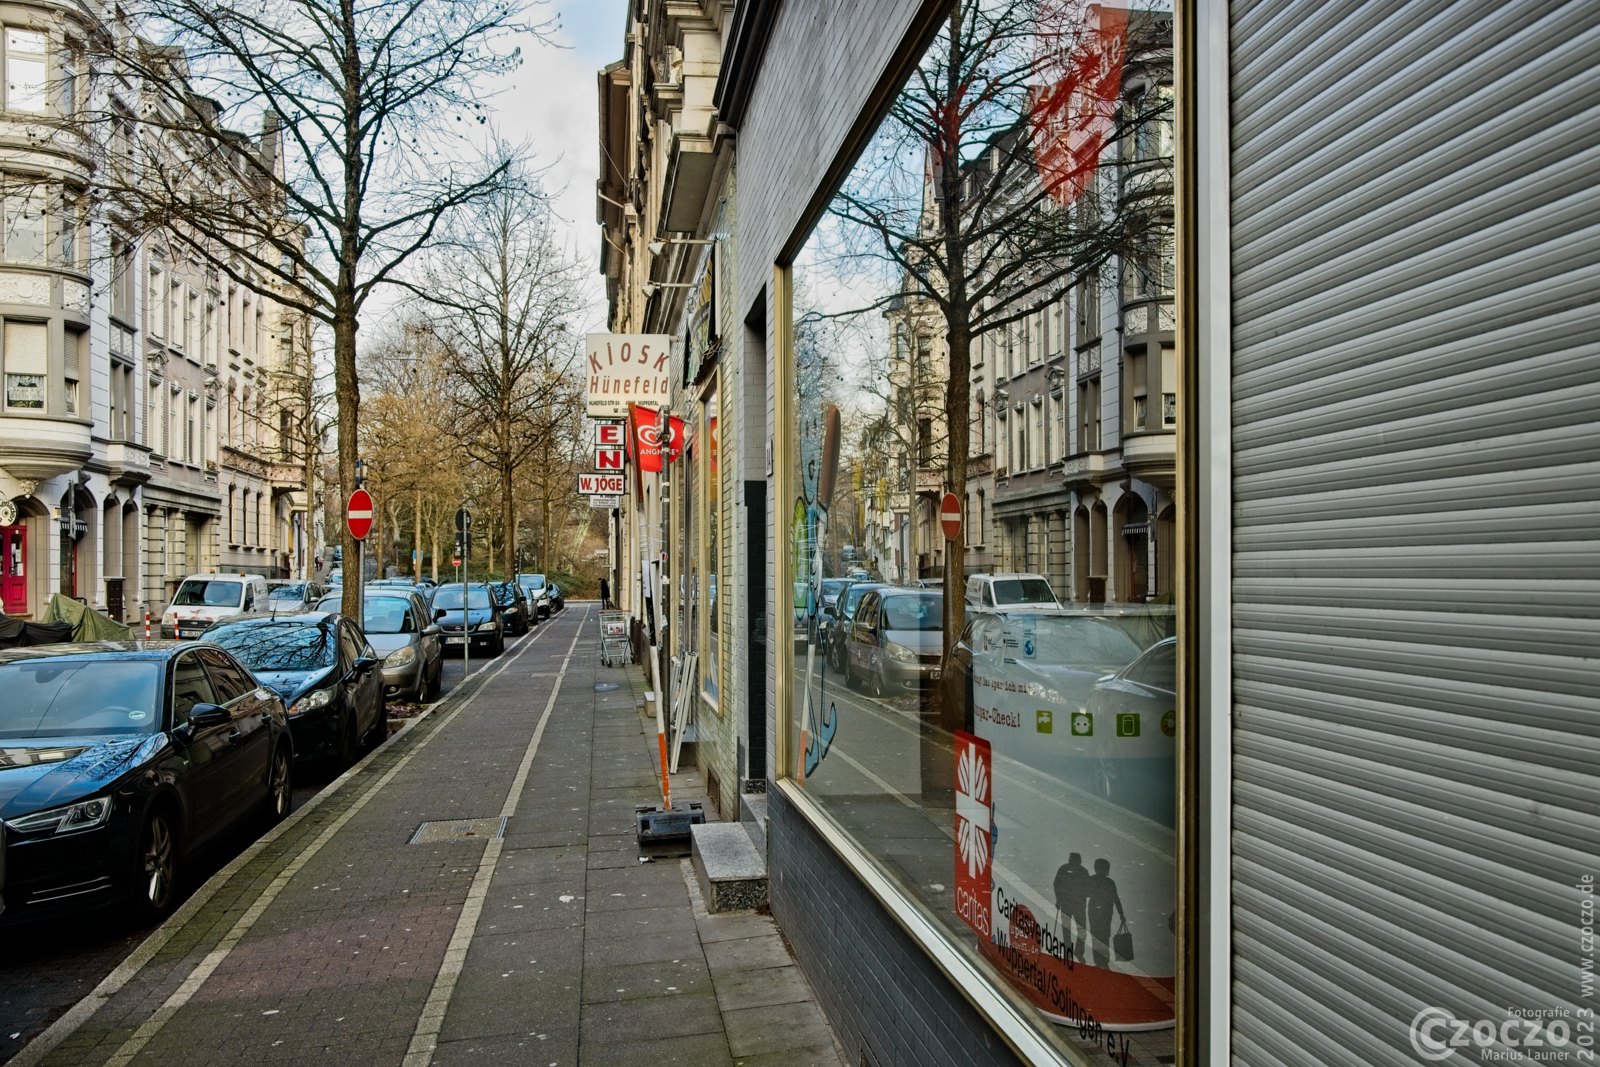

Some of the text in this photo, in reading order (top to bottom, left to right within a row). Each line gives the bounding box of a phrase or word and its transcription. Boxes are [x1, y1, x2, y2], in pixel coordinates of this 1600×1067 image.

[589, 375, 669, 394] Hünefeld
[580, 477, 592, 491] W.
[957, 886, 989, 937] caritas
[997, 887, 1074, 972] Caritasverband
